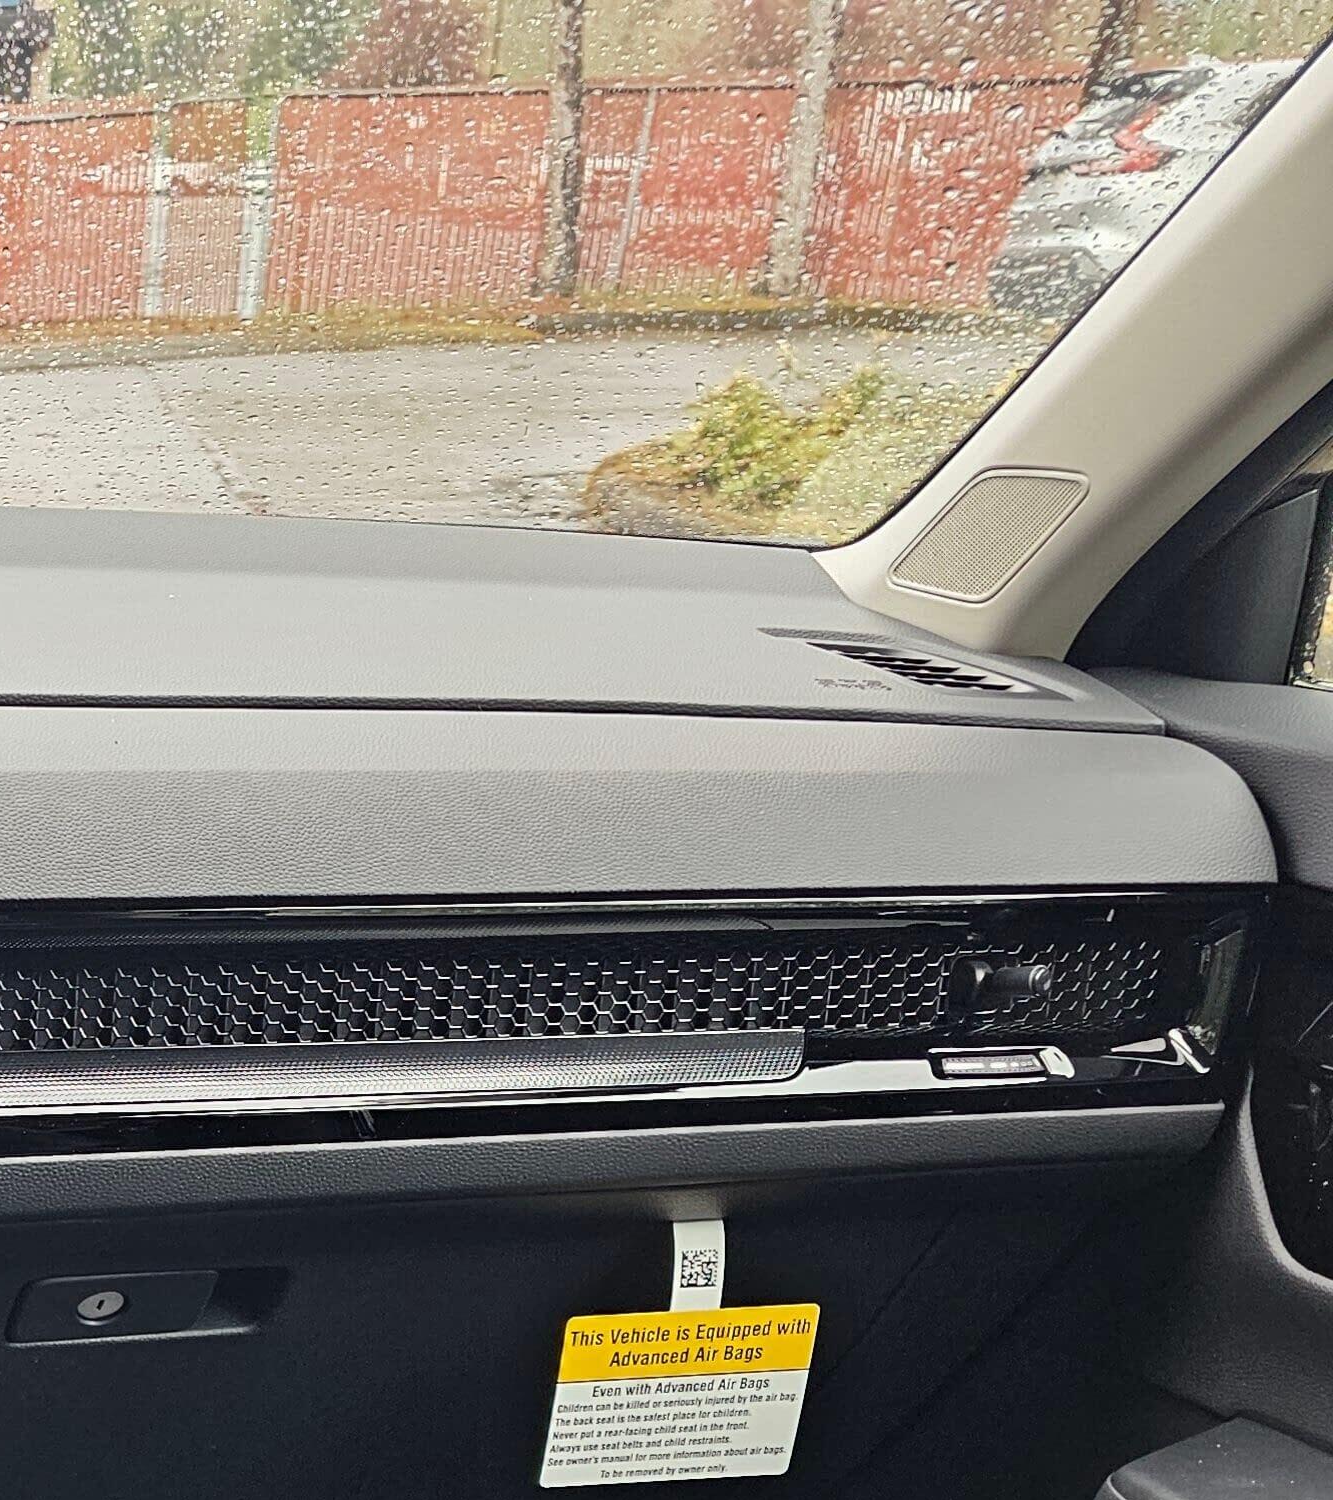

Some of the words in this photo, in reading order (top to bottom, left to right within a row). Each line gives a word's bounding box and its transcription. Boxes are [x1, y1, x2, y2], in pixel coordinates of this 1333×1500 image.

[571, 1330, 604, 1347] This
[610, 1326, 671, 1345] Vehicle
[676, 1325, 690, 1341] is
[696, 1320, 772, 1341] Equipped
[777, 1319, 811, 1336] with
[608, 1347, 690, 1368] Advanced
[694, 1346, 719, 1363] Air
[723, 1345, 764, 1363] Bags
[592, 1386, 622, 1398] Even
[625, 1383, 652, 1396] with
[654, 1380, 715, 1394] Advanced
[717, 1379, 736, 1391] Air
[739, 1377, 770, 1391] Bags
[557, 1404, 593, 1414] Children
[595, 1403, 611, 1412] can
[613, 1402, 624, 1410] be
[626, 1400, 650, 1410] killed
[653, 1400, 662, 1408] or
[664, 1397, 702, 1408] seriously
[705, 1395, 735, 1406] injured
[737, 1395, 748, 1404] by
[749, 1394, 763, 1403] the
[765, 1393, 777, 1402] air
[780, 1393, 799, 1402] bag.
[555, 1418, 573, 1427] The
[573, 1416, 593, 1426] back
[595, 1415, 615, 1425] seat
[617, 1415, 625, 1423] is
[627, 1414, 642, 1423] the
[644, 1412, 671, 1422] safest
[672, 1411, 696, 1422] place
[698, 1410, 711, 1419] for
[712, 1408, 752, 1418] children.
[552, 1431, 579, 1441] Never
[580, 1430, 594, 1440] put
[604, 1427, 652, 1437] rear-facing
[654, 1425, 676, 1434] child
[678, 1424, 697, 1433] seat
[699, 1423, 708, 1432] in
[710, 1422, 724, 1431] the
[726, 1421, 750, 1430] front.
[549, 1444, 581, 1454] Always
[583, 1444, 599, 1452] use
[600, 1442, 620, 1451] seat
[622, 1440, 643, 1450] belts
[645, 1439, 662, 1448] and
[664, 1437, 687, 1447] child
[688, 1435, 732, 1446] restraints.
[547, 1458, 564, 1467] See
[565, 1456, 599, 1466] owner's
[600, 1454, 634, 1463] manual
[635, 1453, 647, 1461] for
[648, 1452, 671, 1461] more
[673, 1448, 722, 1459] information
[723, 1447, 748, 1457] about
[750, 1446, 762, 1455] air
[763, 1445, 787, 1456] bags.
[600, 1470, 611, 1479] To
[612, 1469, 623, 1478] be
[625, 1466, 665, 1477] removed
[665, 1466, 676, 1476] by
[678, 1465, 706, 1474] owner
[707, 1464, 728, 1473] only.
